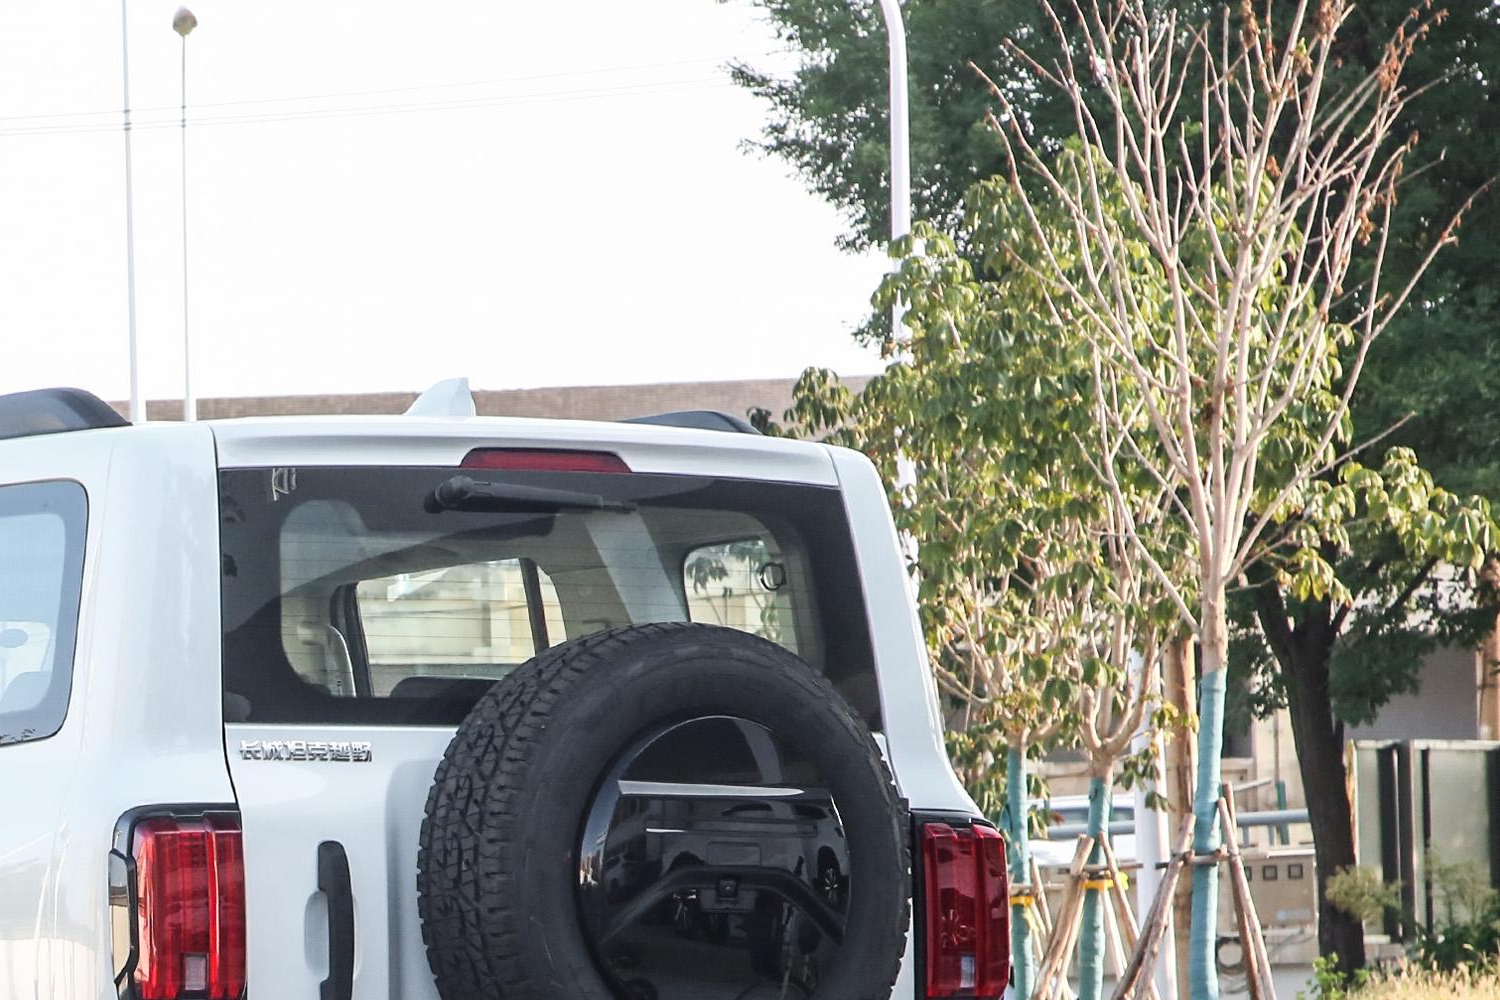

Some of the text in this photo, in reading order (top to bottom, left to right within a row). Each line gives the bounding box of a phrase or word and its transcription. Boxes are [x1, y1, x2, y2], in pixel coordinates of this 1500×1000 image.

[240, 740, 372, 762] 长城坦克越野
